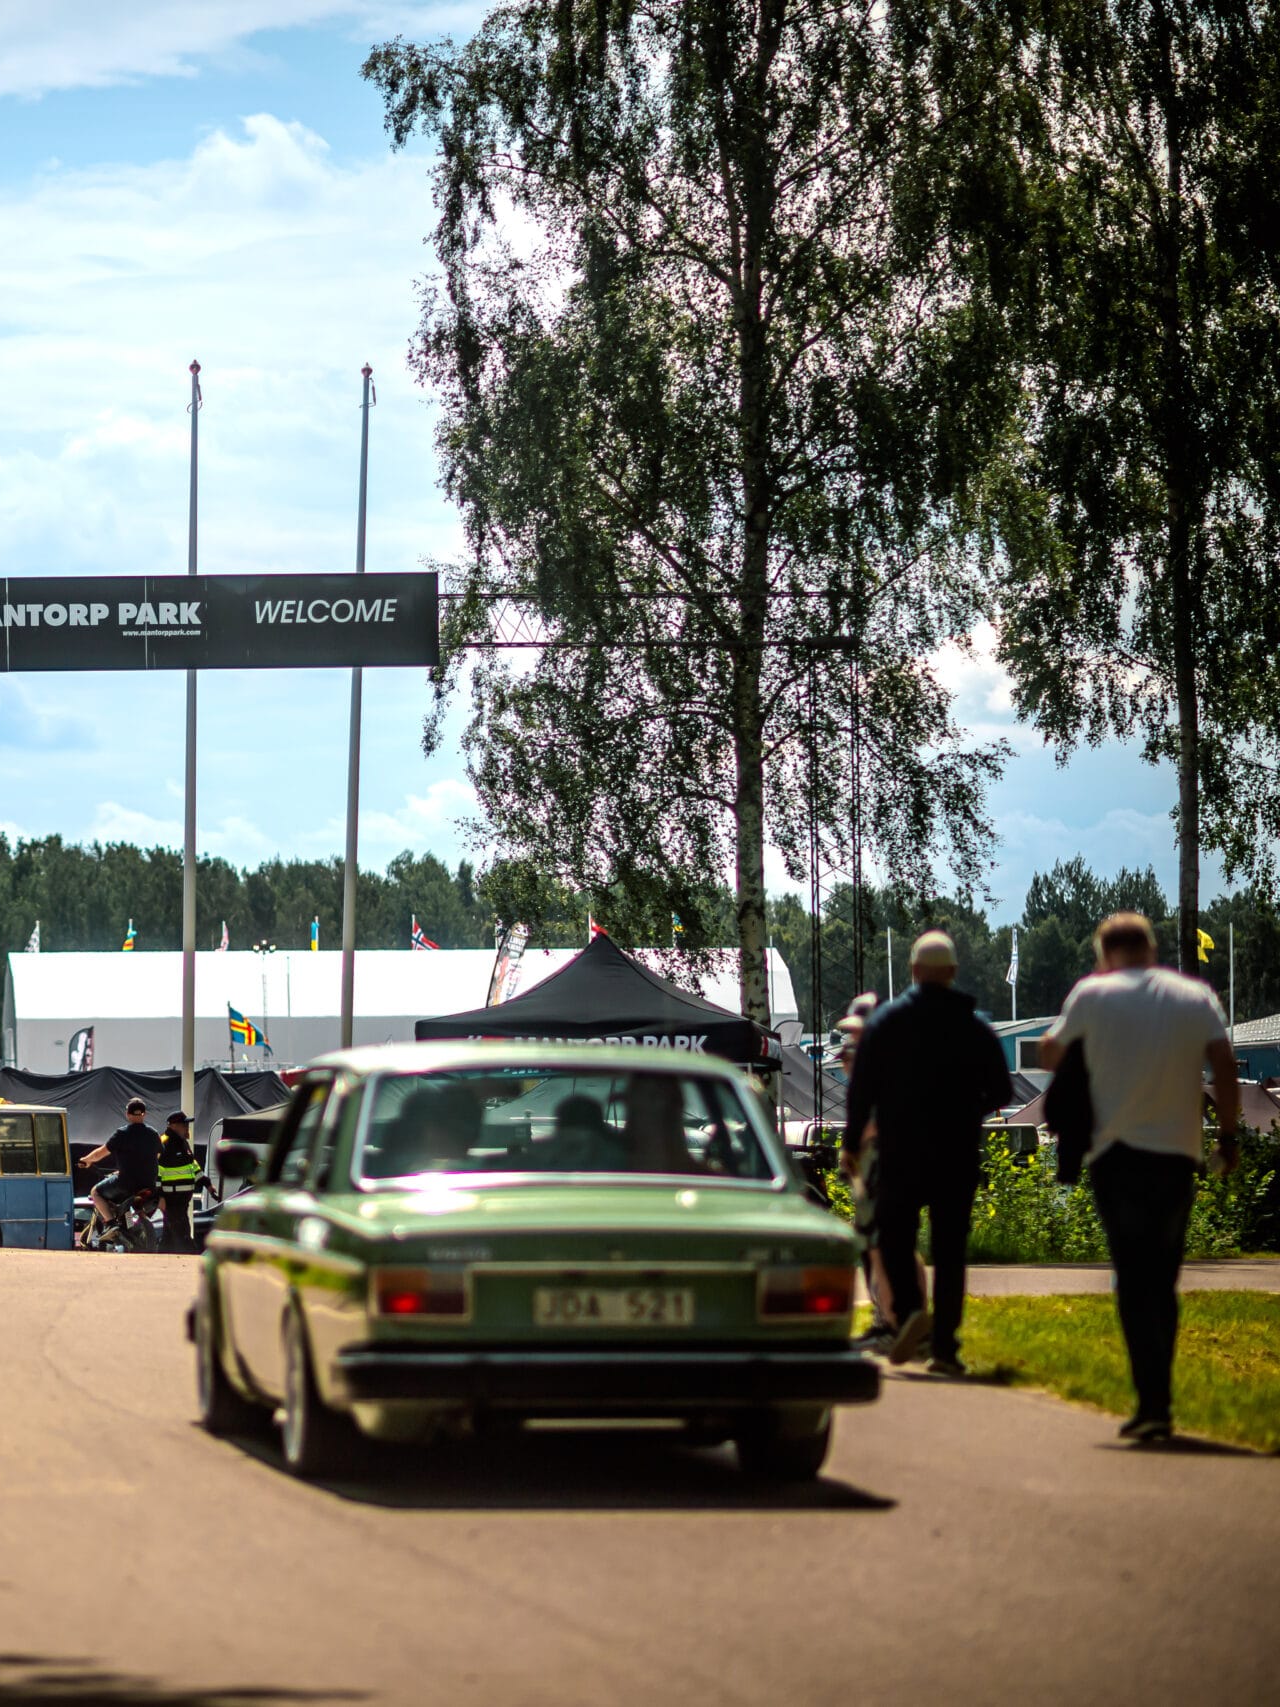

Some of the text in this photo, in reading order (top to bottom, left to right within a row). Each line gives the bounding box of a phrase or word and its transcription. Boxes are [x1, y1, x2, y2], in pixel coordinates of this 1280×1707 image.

[118, 601, 202, 626] PARK
[254, 598, 398, 624] WELCOME
[122, 629, 201, 638] www.mantorppark.com
[627, 1291, 682, 1318] 521
